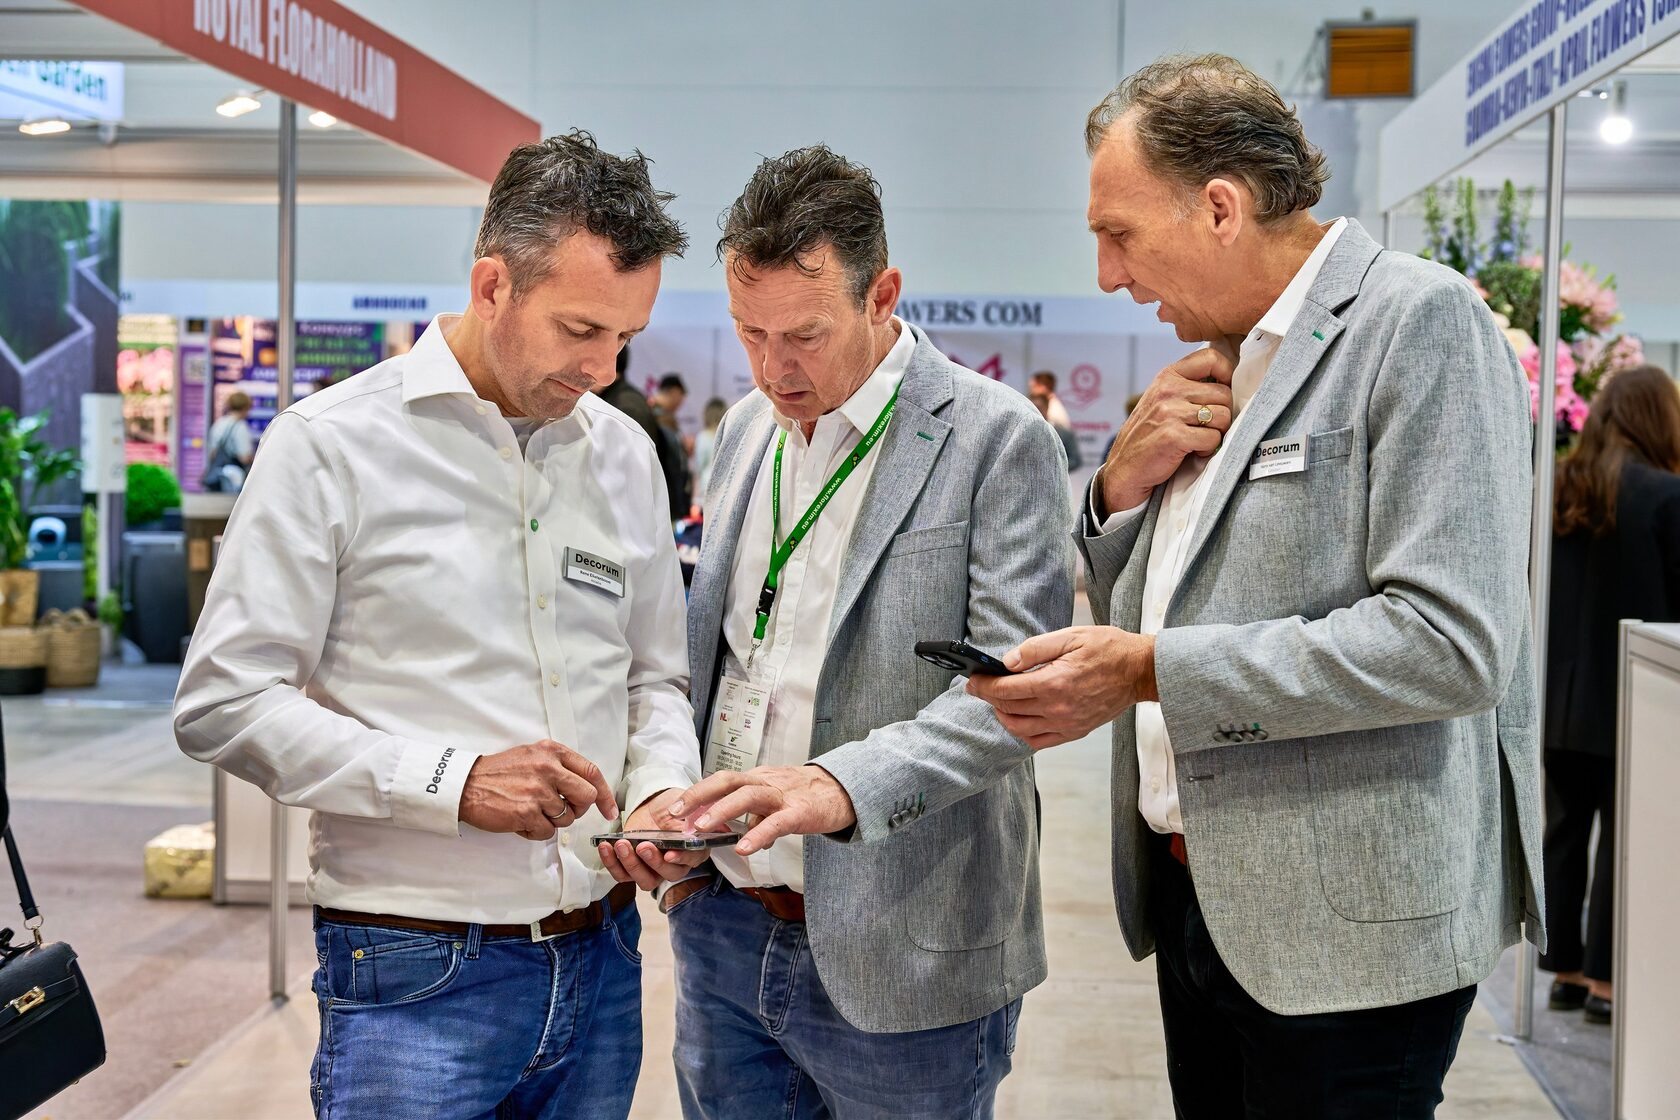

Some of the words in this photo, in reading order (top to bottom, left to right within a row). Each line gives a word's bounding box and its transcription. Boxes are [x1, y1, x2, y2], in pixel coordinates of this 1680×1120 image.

[896, 301, 976, 325] WERS
[982, 301, 1043, 327] COM
[1256, 442, 1300, 459] Decorum
[801, 477, 842, 530] www.florexim.eu
[575, 553, 620, 578] Decorum
[425, 747, 457, 794] Decorum
